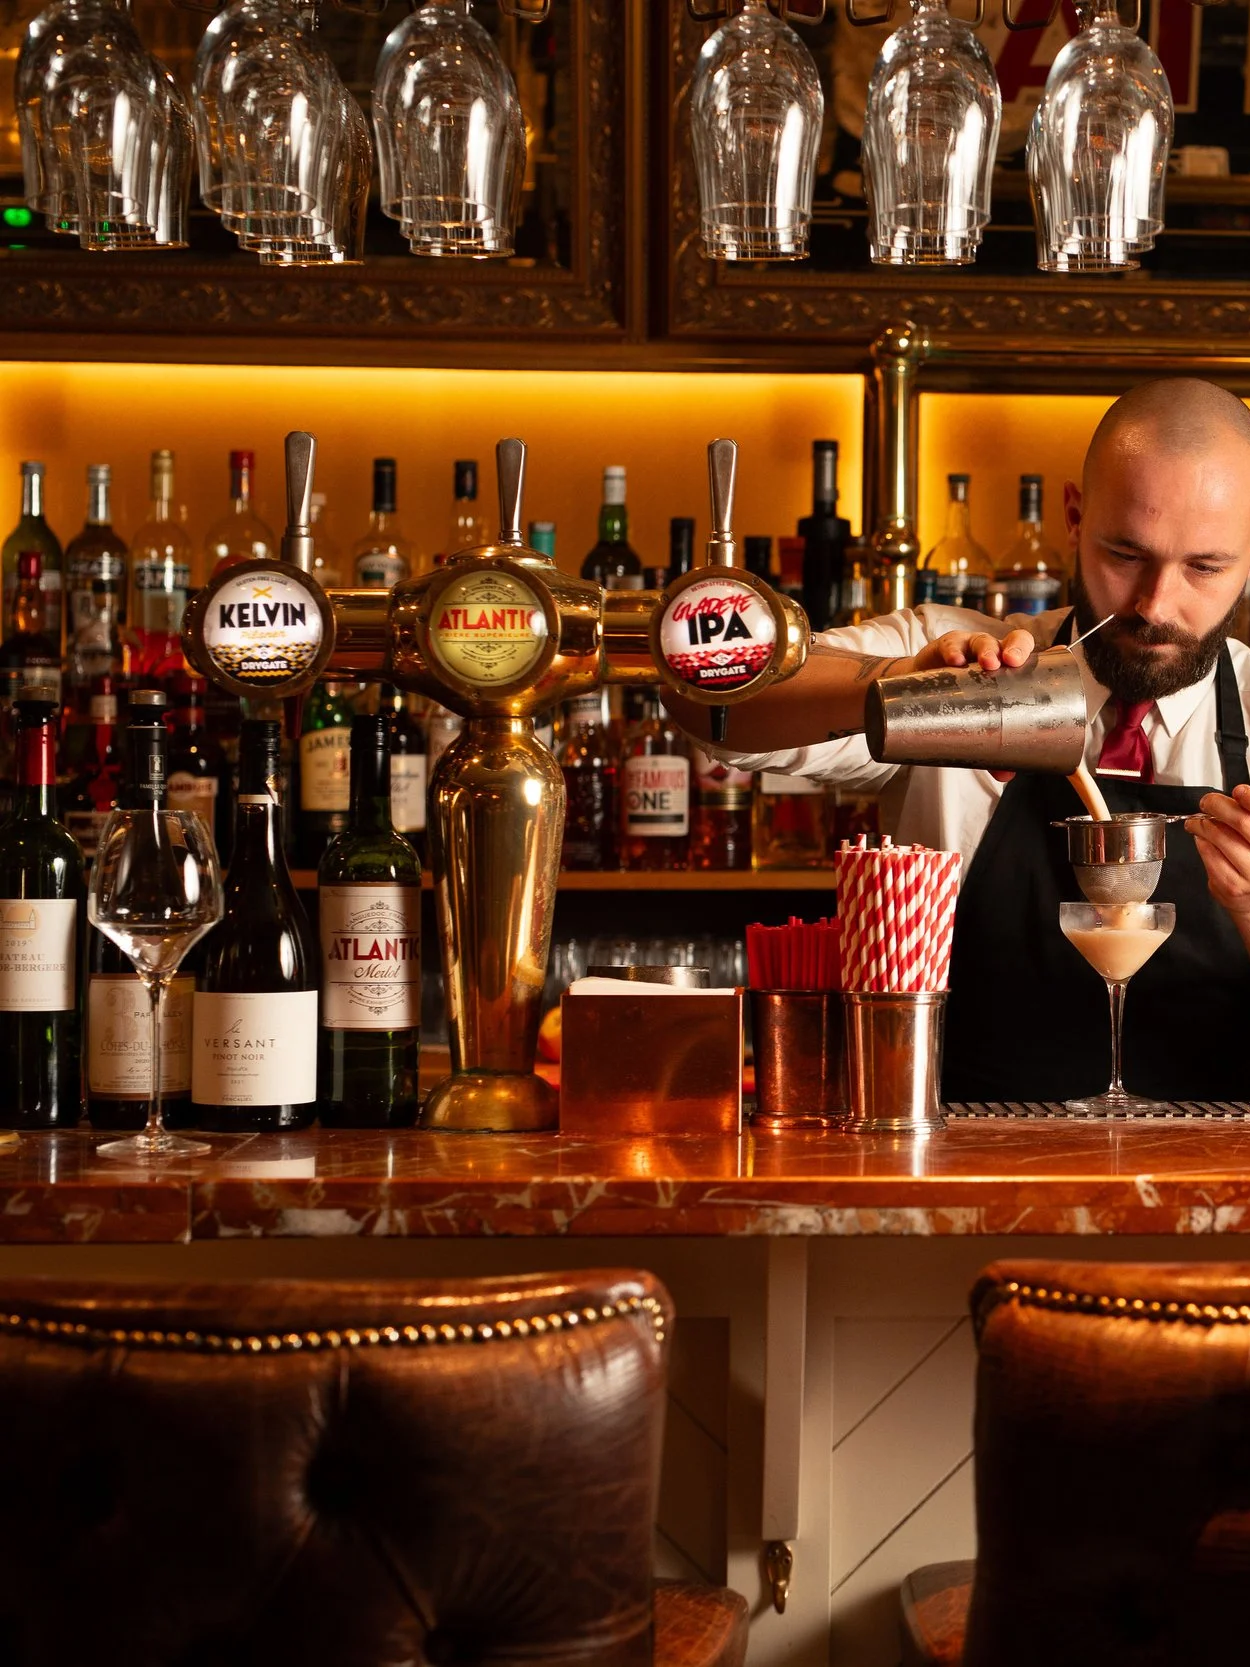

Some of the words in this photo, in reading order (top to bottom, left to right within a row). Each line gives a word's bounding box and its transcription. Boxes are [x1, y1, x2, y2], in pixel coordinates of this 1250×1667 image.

[219, 602, 306, 629] KELVIN
[672, 593, 755, 622] GLADEYE
[688, 610, 753, 646] IPA
[241, 660, 288, 671] DRYGATE
[700, 665, 747, 678] DRYGATE
[627, 790, 671, 810] ONE
[328, 938, 420, 961] ATLANTIC
[354, 963, 401, 979] Merlot
[204, 1038, 276, 1049] VERSANT
[213, 1053, 238, 1061] PINOT
[241, 1053, 265, 1061] NOIR
